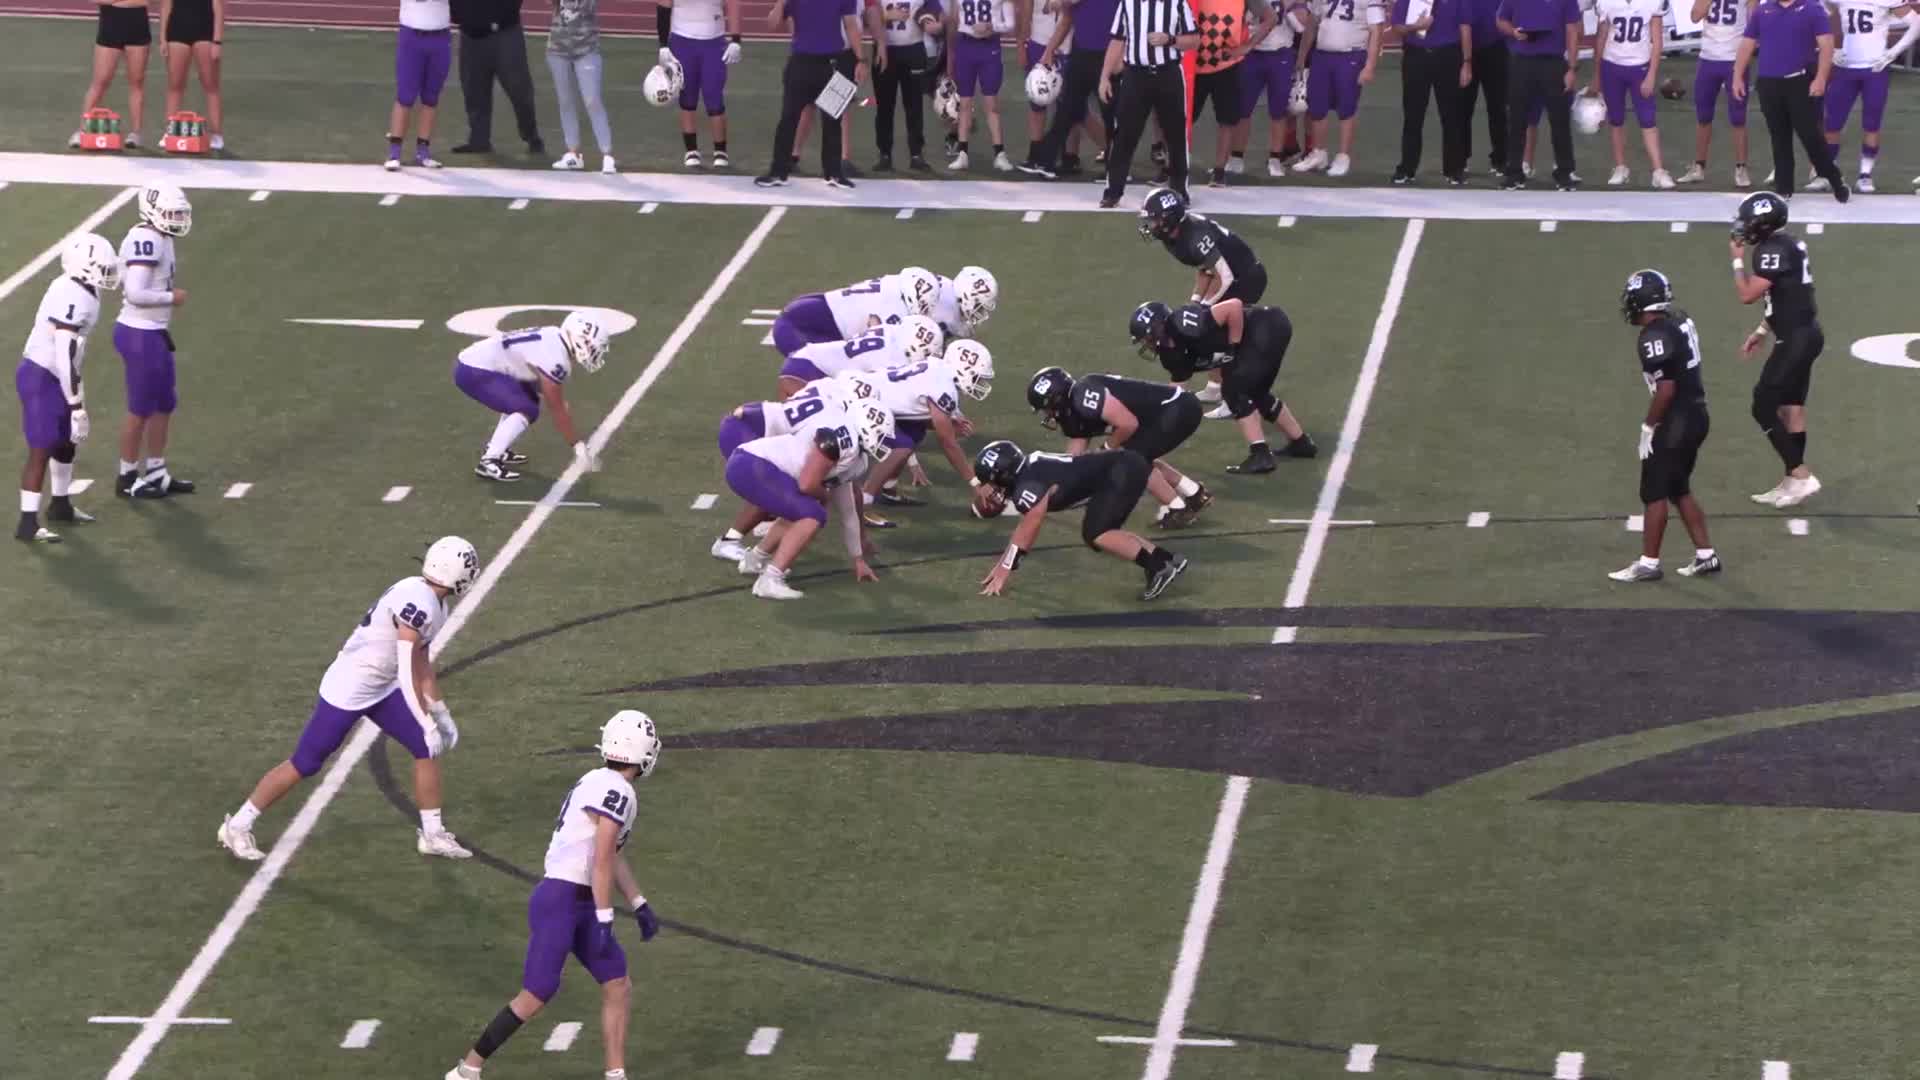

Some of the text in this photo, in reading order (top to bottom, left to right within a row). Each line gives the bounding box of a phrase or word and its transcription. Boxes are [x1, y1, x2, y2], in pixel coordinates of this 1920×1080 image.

[1707, 0, 1738, 25] 35
[1849, 9, 1874, 33] 16
[1613, 16, 1642, 43] 30
[95, 137, 107, 147] G
[176, 140, 187, 150] G
[1160, 194, 1177, 208] 22
[134, 241, 154, 256] 10
[1197, 235, 1215, 255] 22
[1760, 254, 1780, 269] 23
[914, 278, 933, 296] 67
[973, 278, 990, 295] 87
[65, 304, 75, 320] 1
[1137, 307, 1154, 324] 77
[1183, 311, 1198, 326] 77
[582, 322, 599, 338] 31
[915, 326, 934, 345] 59
[1643, 340, 1664, 358] 38
[959, 350, 979, 367] 53
[853, 380, 872, 399] 79
[1083, 389, 1100, 410] 65
[866, 407, 885, 425] 55
[1018, 490, 1038, 509] 70
[400, 602, 427, 628] 26
[602, 789, 628, 816] 21
